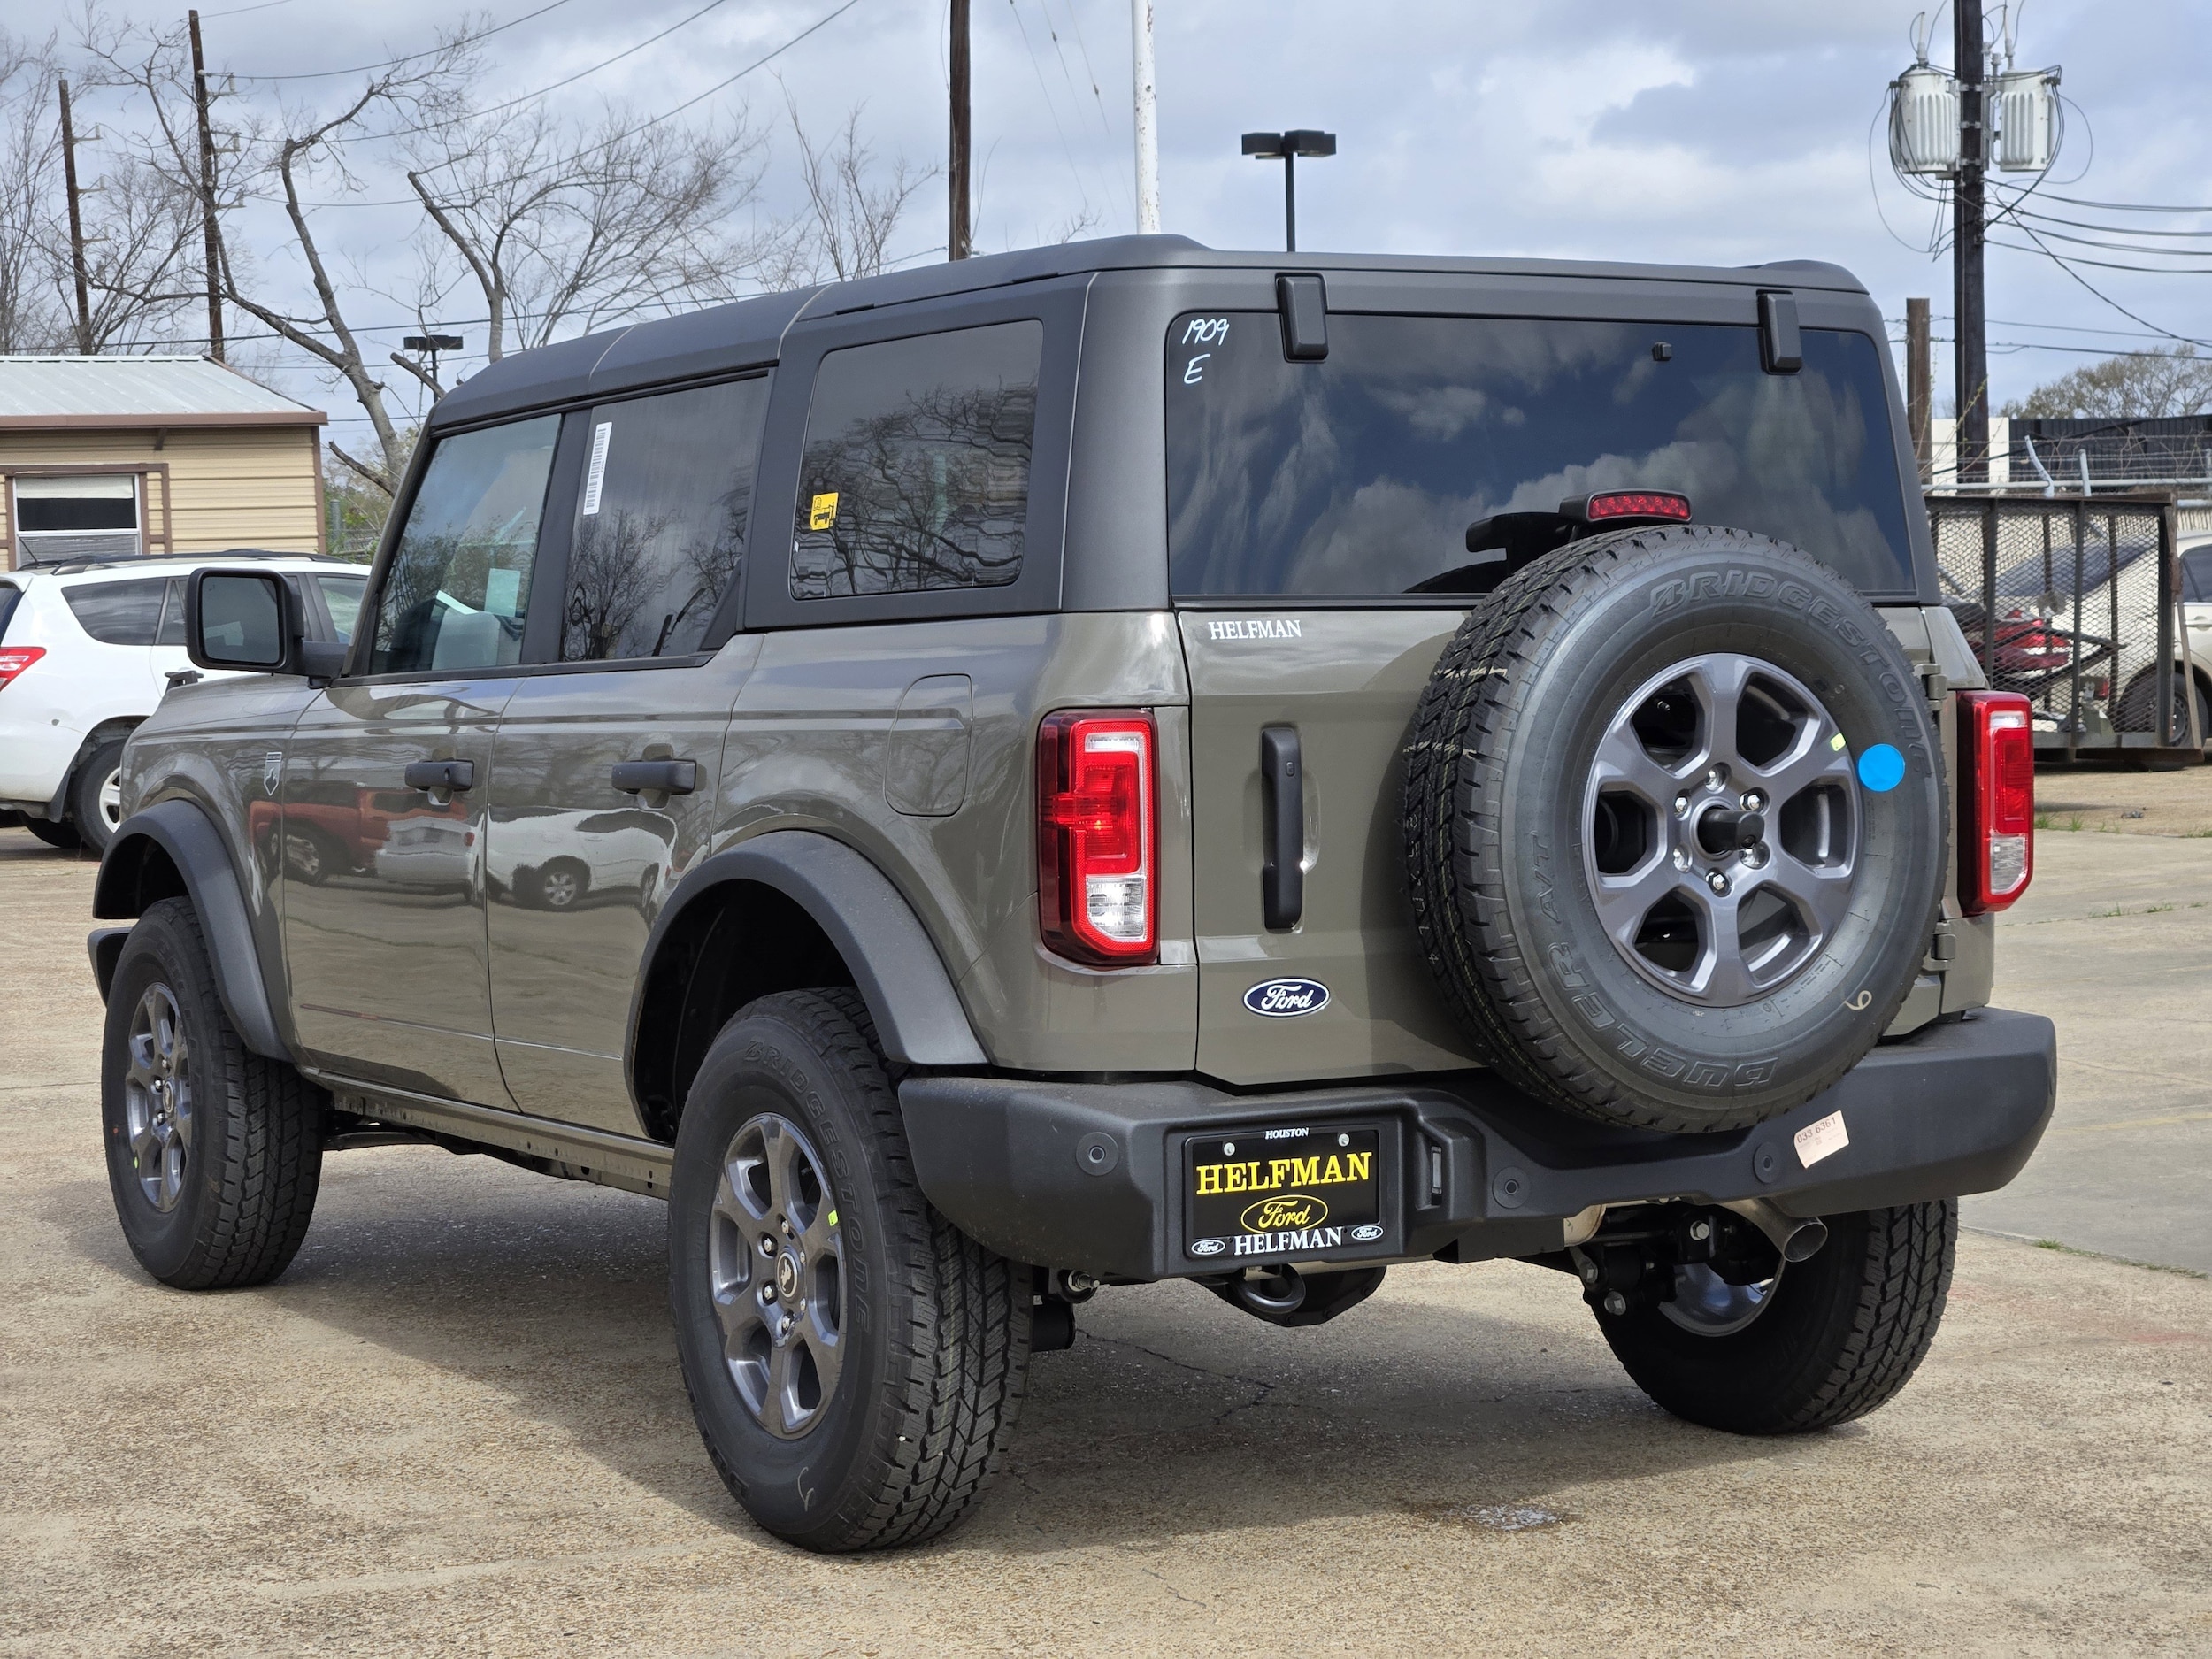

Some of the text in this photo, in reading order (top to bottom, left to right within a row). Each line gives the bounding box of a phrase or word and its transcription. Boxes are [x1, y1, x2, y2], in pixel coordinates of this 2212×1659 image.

[1181, 319, 1230, 346] 1909
[1184, 354, 1211, 384] E
[1208, 619, 1302, 640] HELFMAN
[1649, 569, 1932, 779] BRIDGESTONE
[1261, 984, 1314, 1010] Ford
[1548, 941, 1778, 1087] DUELER
[1265, 1127, 1310, 1140] HOUSTON
[1796, 1129, 1814, 1144] 033
[743, 1039, 871, 1334] BRIDGESTONE
[1196, 1152, 1372, 1194] HELFMAN
[1258, 1200, 1311, 1229] Ford
[1234, 1226, 1343, 1256] HELFMAN
